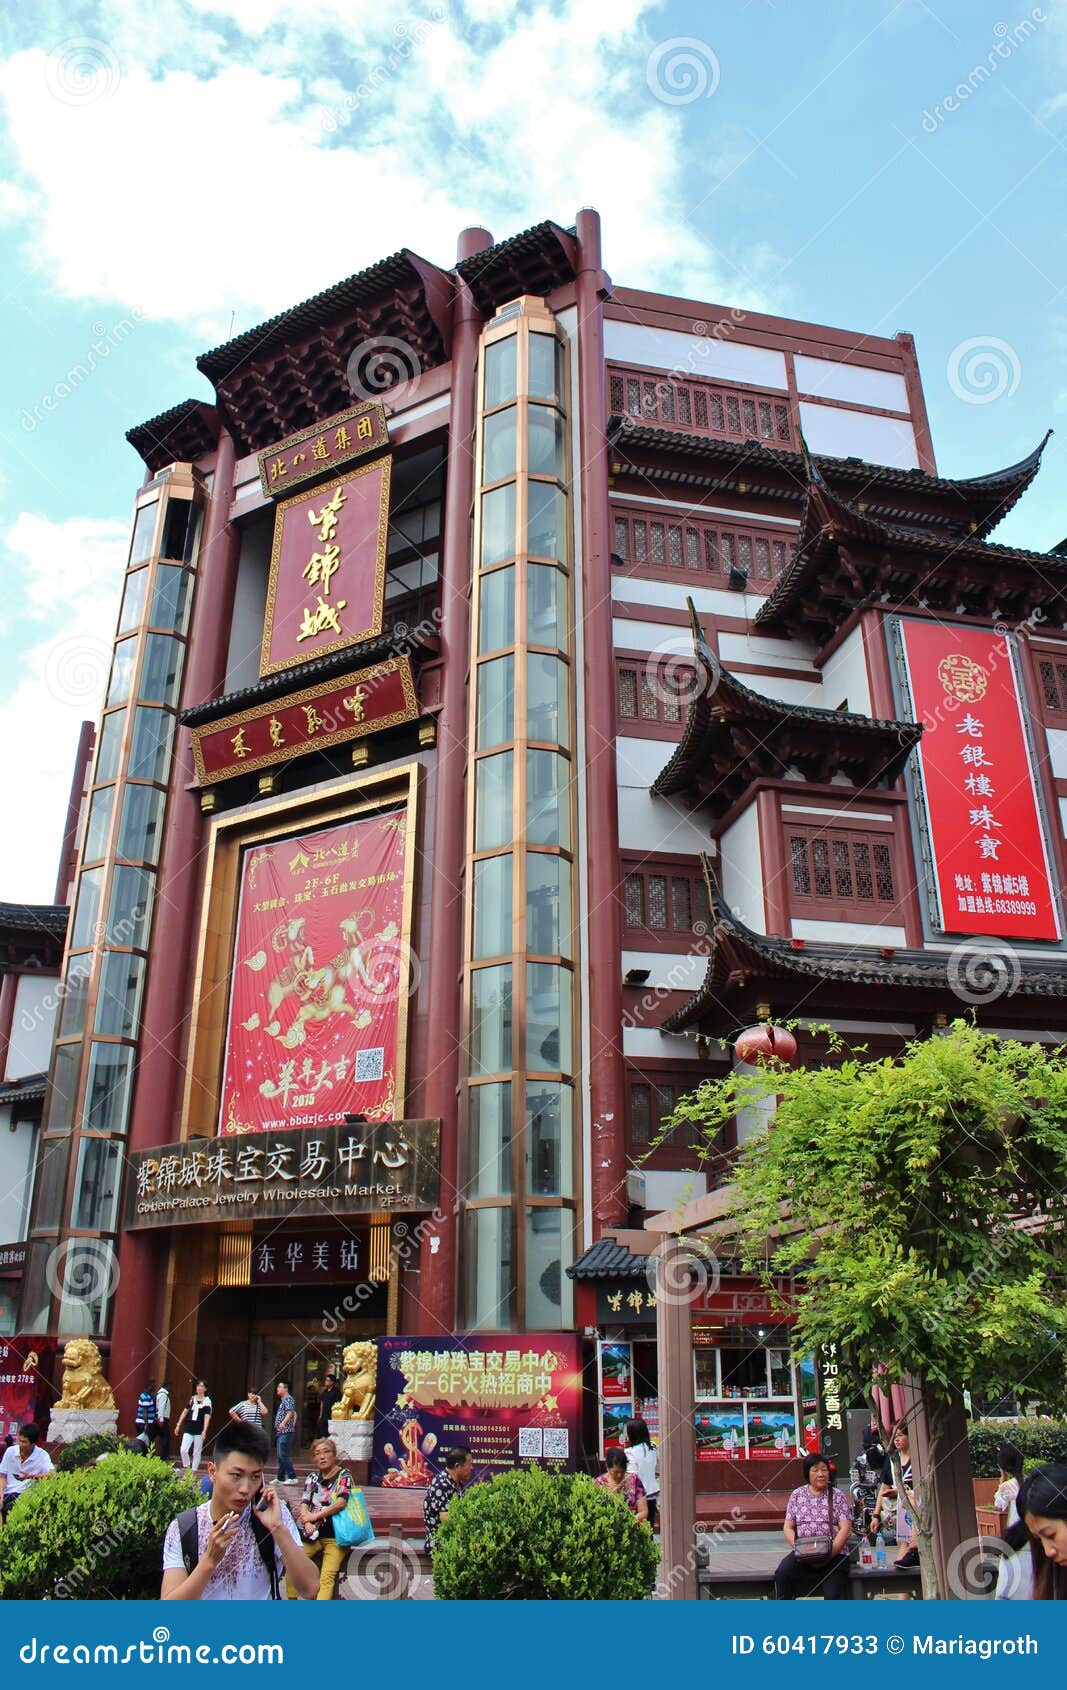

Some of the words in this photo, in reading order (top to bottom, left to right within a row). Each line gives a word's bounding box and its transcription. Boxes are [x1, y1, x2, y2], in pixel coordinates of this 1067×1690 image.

[270, 415, 374, 482] 北八道集团
[304, 873, 340, 890] 2F-6F
[259, 1054, 350, 1108] 羊年大吉
[292, 1094, 315, 1108] 2015
[136, 1136, 409, 1197] 紫锦城珠宝交易中心
[137, 1201, 171, 1214] Golden
[172, 1196, 209, 1209] Palace
[212, 1189, 258, 1204] Jewelry
[263, 1186, 340, 1201] Wholesale
[345, 1182, 402, 1197] Market
[258, 1239, 358, 1273] 东华美钻
[400, 1350, 558, 1372] 紫锦城珠宝交易中心
